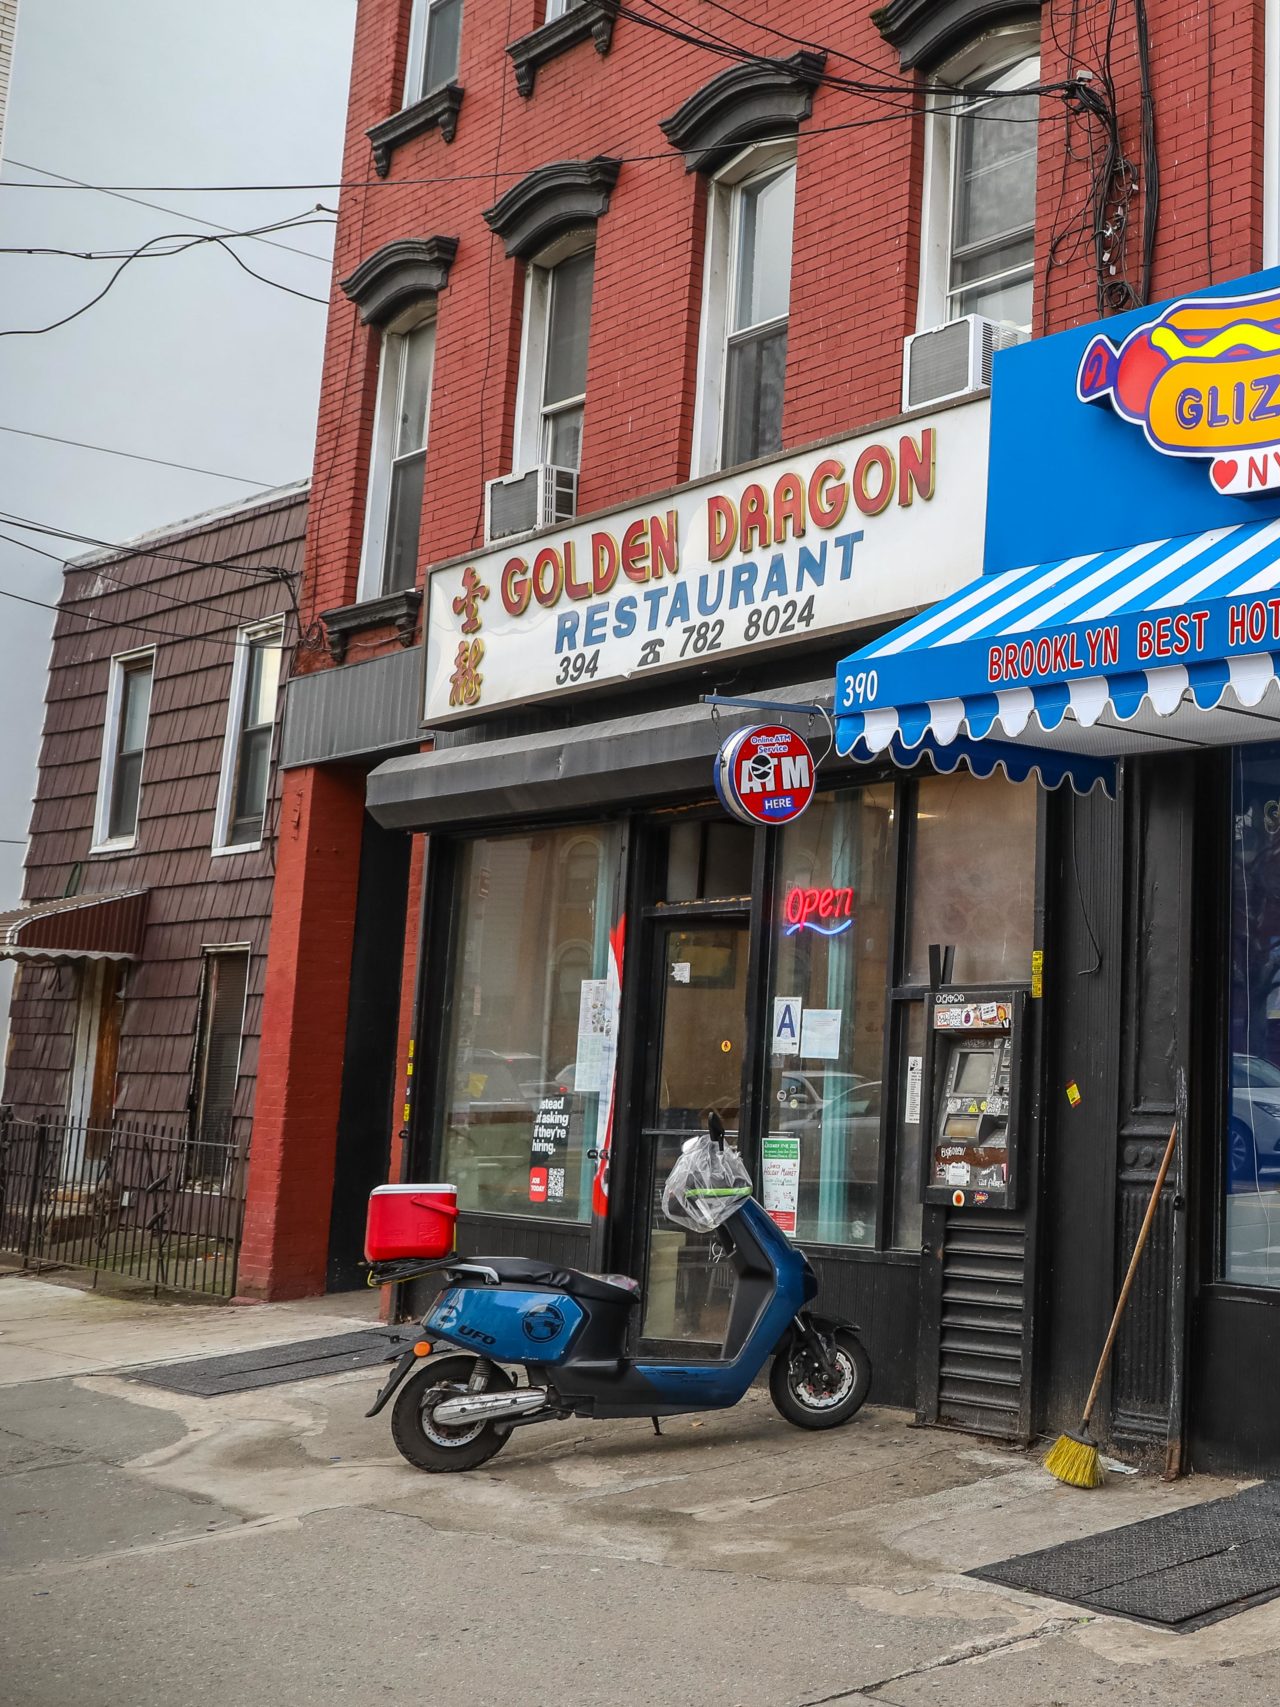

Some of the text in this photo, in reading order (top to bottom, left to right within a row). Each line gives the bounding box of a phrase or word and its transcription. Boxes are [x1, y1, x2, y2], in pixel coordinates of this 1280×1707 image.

[501, 428, 936, 616] GOLDEN DRAGON
[554, 530, 864, 654] RESTAURANT
[556, 596, 816, 685] 394 782 8024
[986, 626, 1120, 682] BROOKLYN
[1138, 610, 1209, 661] BEST
[842, 669, 878, 707] 390
[751, 733, 791, 745] Online ATM
[758, 744, 789, 754] Service
[740, 755, 810, 794] ATM
[765, 798, 792, 810] HERE
[776, 1004, 796, 1038] A
[542, 1111, 569, 1127] asking
[539, 1125, 567, 1141] they're
[532, 1139, 556, 1155] hiring.
[458, 1325, 497, 1344] UFO
